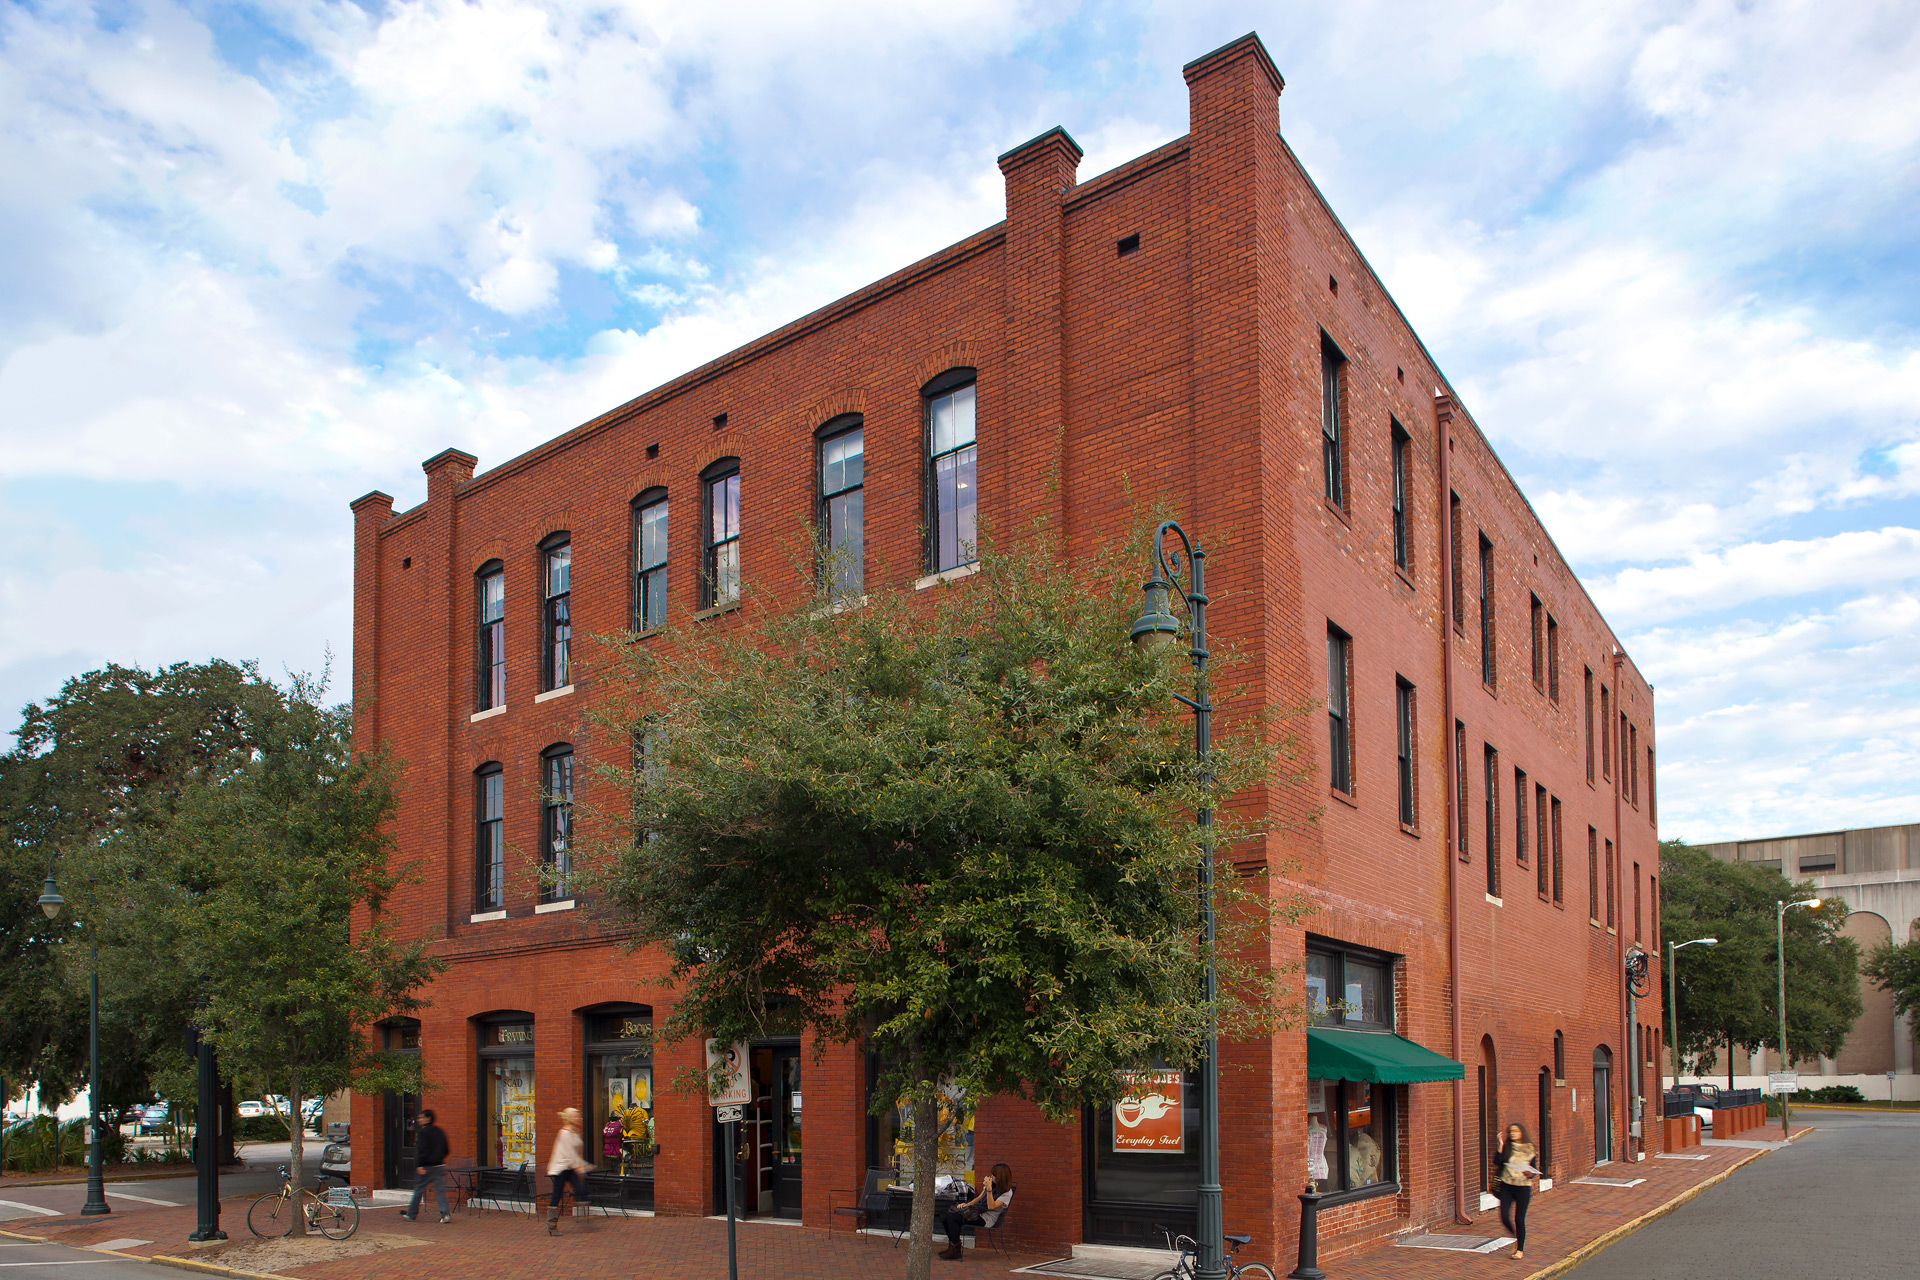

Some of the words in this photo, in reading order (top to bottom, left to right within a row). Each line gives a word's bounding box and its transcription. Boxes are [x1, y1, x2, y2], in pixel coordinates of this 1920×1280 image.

[503, 1079, 523, 1088] SCAD
[718, 1089, 747, 1100] ARKING
[515, 1132, 534, 1141] SCAD
[1116, 1134, 1156, 1147] Everyday
[1158, 1135, 1181, 1145] Fuel
